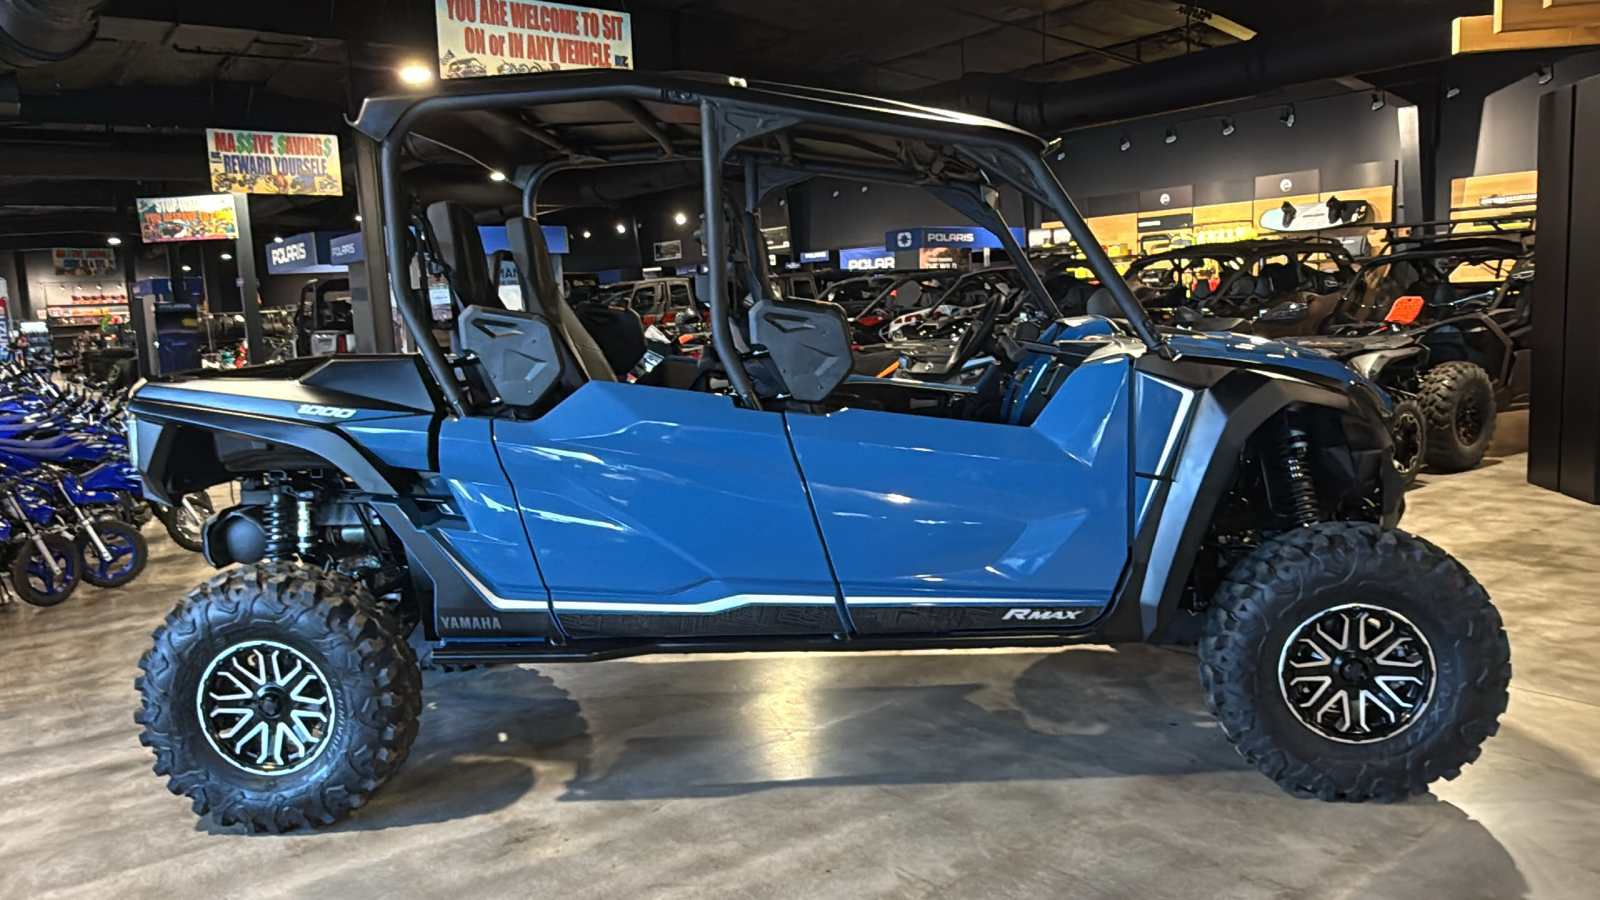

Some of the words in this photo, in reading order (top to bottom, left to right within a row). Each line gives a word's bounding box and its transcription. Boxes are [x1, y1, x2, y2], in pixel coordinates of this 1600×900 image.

[446, 0, 476, 23] YOU
[479, 0, 509, 27] ARE
[509, 2, 579, 36] WELCOME
[581, 12, 599, 38] TO
[602, 14, 624, 41] SIT
[464, 26, 486, 54] ON
[488, 33, 505, 57] or
[507, 32, 524, 59] IN
[526, 34, 555, 62] ANY
[557, 37, 612, 67] VEHICLE
[223, 154, 272, 176] REWARD
[273, 156, 327, 177] YOURSELF
[927, 232, 974, 242] POLARIS
[272, 242, 306, 265] POLARIS
[331, 242, 356, 257] POLARIS
[297, 404, 356, 419] 1000
[1001, 608, 1084, 620] RMAX
[439, 616, 503, 630] YAMAHA
